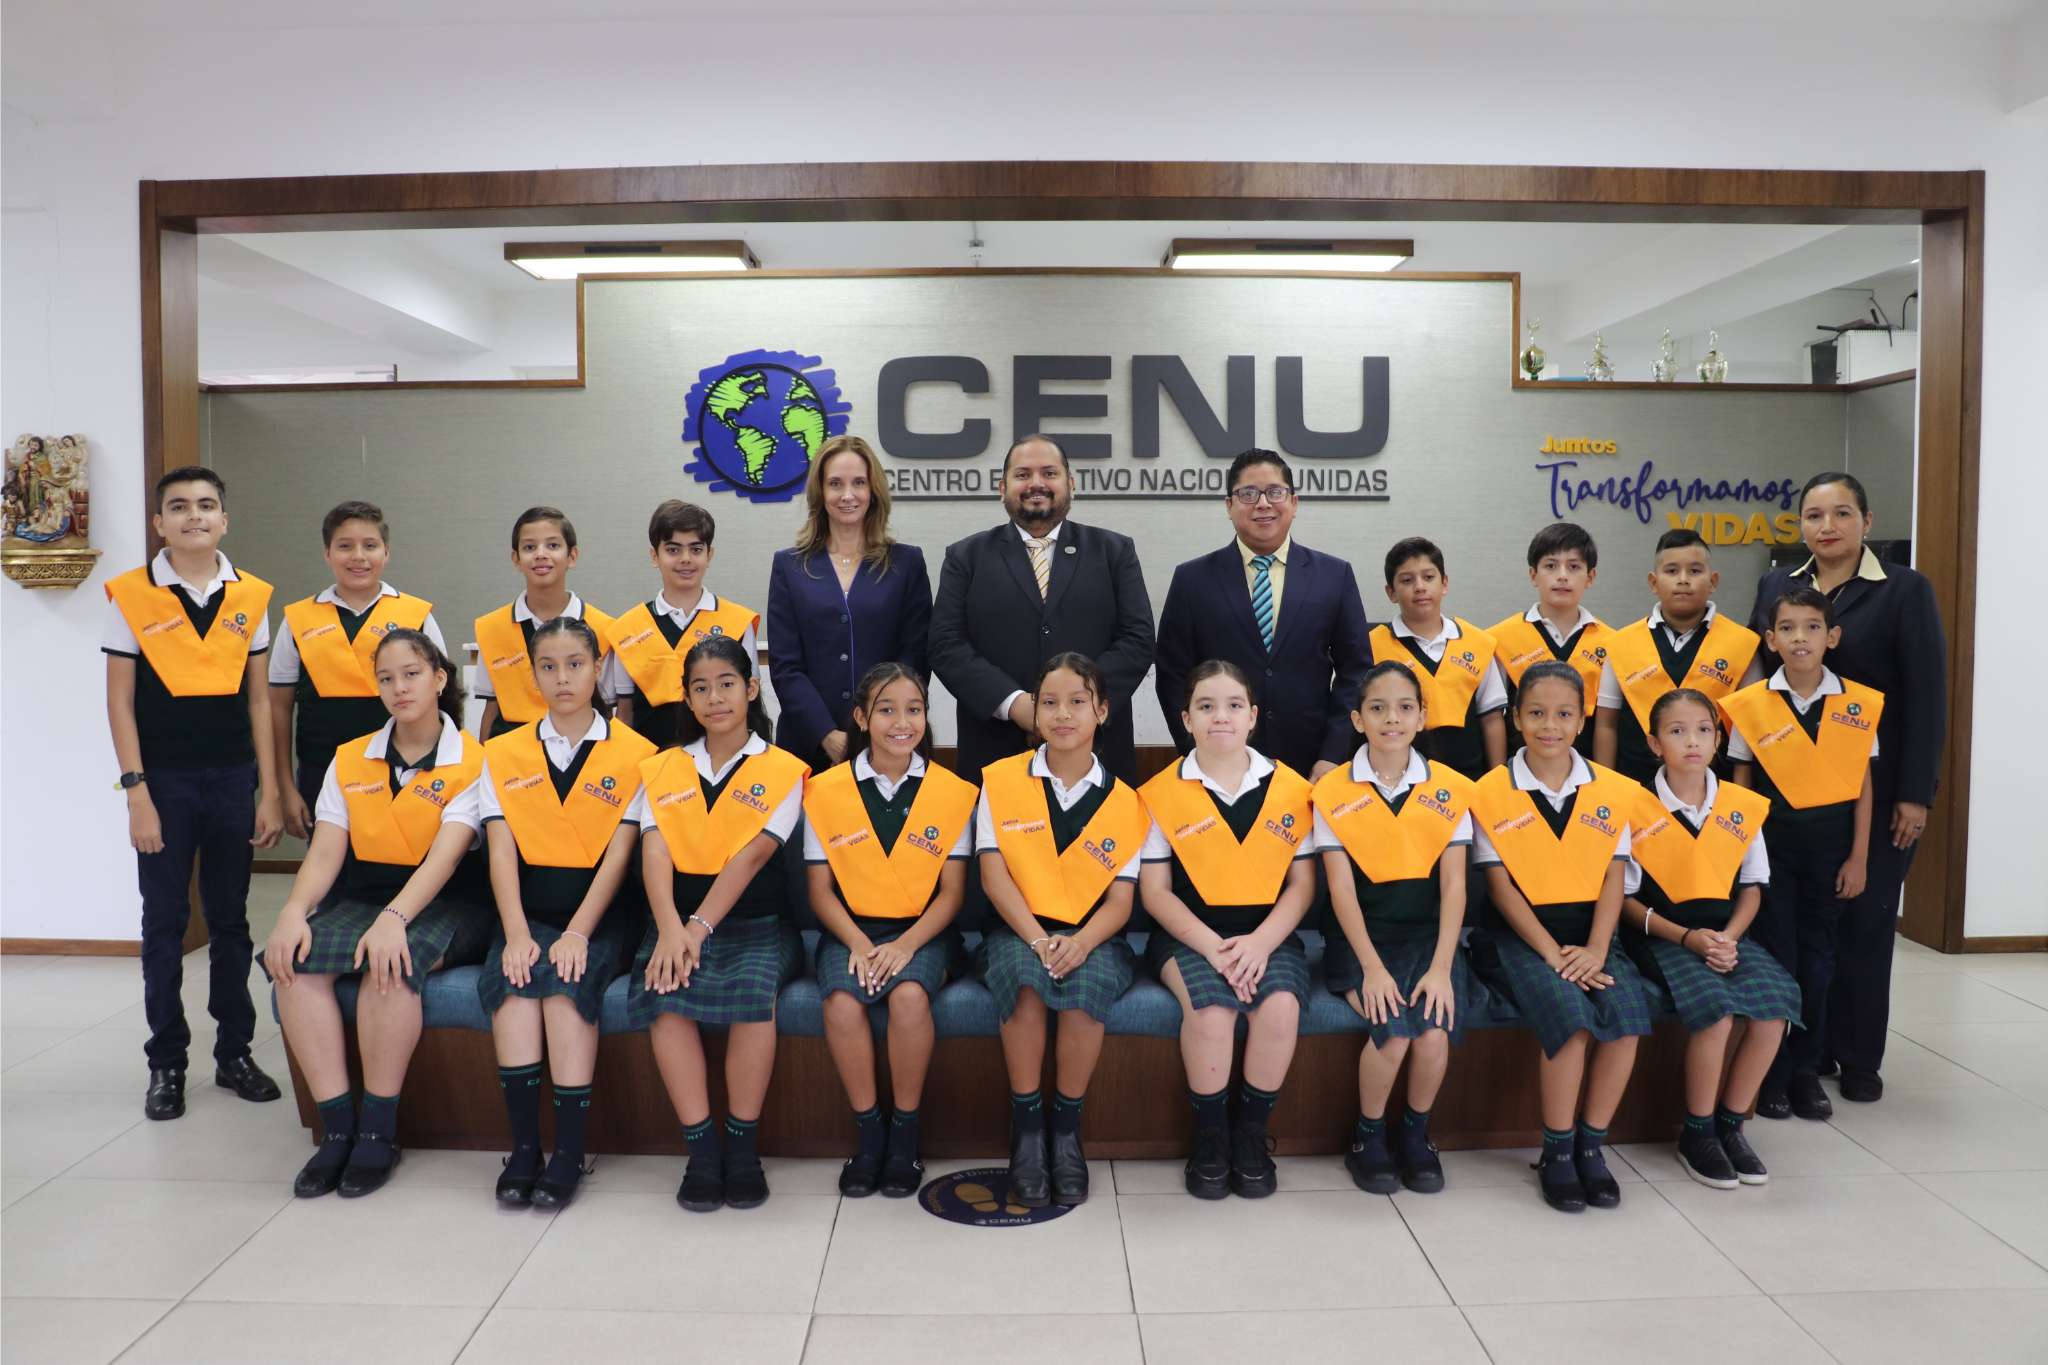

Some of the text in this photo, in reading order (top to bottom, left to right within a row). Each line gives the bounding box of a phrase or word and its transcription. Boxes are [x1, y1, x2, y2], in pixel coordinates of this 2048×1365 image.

[878, 355, 1390, 459] CENU
[1540, 435, 1617, 454] Juntos
[1535, 461, 1801, 524] Transformamos
[1700, 664, 1734, 687] CENU
[1831, 712, 1871, 728] CENU
[584, 783, 622, 806] CENU
[732, 789, 769, 813] CENU
[1418, 793, 1456, 819] CENU
[1266, 819, 1299, 845] CENU
[1580, 813, 1617, 836] CENU
[1715, 815, 1748, 841] CENU
[907, 832, 943, 856] CENU
[1084, 840, 1117, 869] CENU
